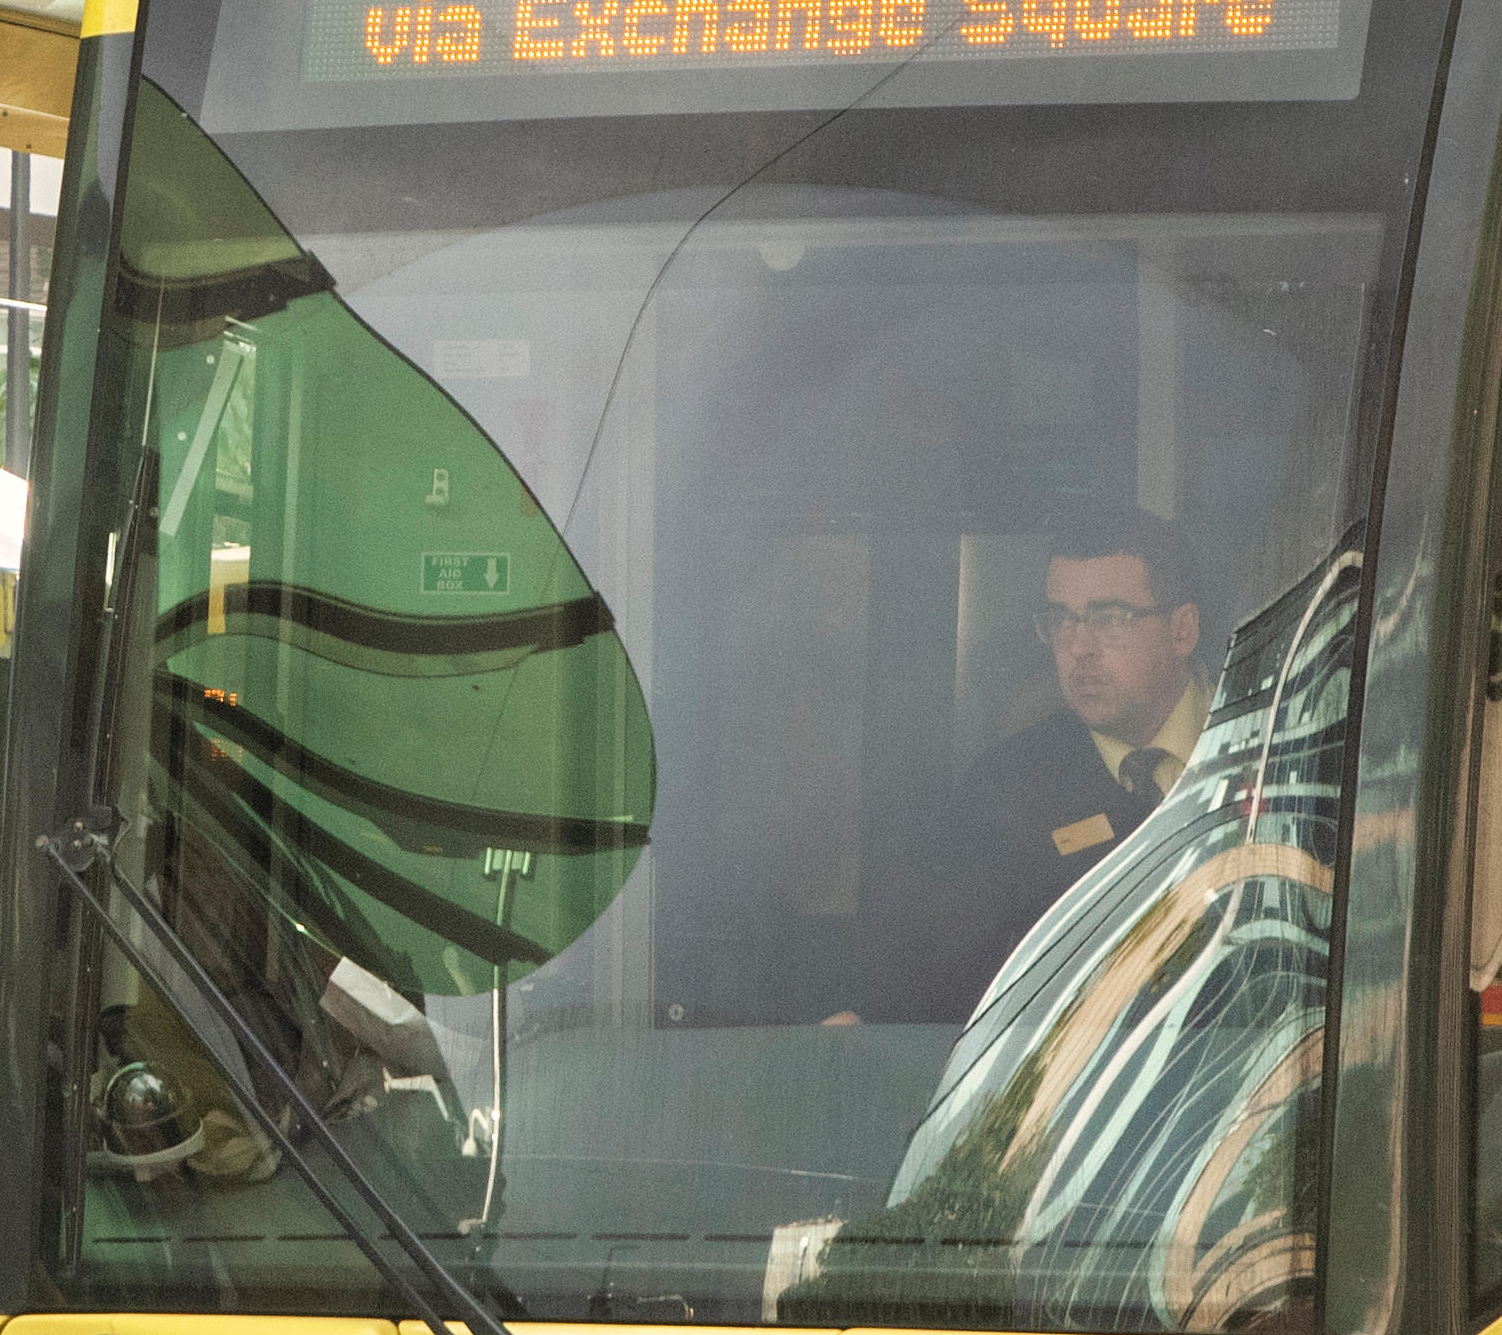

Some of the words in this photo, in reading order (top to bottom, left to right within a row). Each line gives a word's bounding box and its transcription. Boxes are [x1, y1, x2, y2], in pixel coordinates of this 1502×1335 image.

[431, 557, 471, 568] FIRST
[438, 569, 463, 579] AID
[436, 580, 464, 591] BOX
